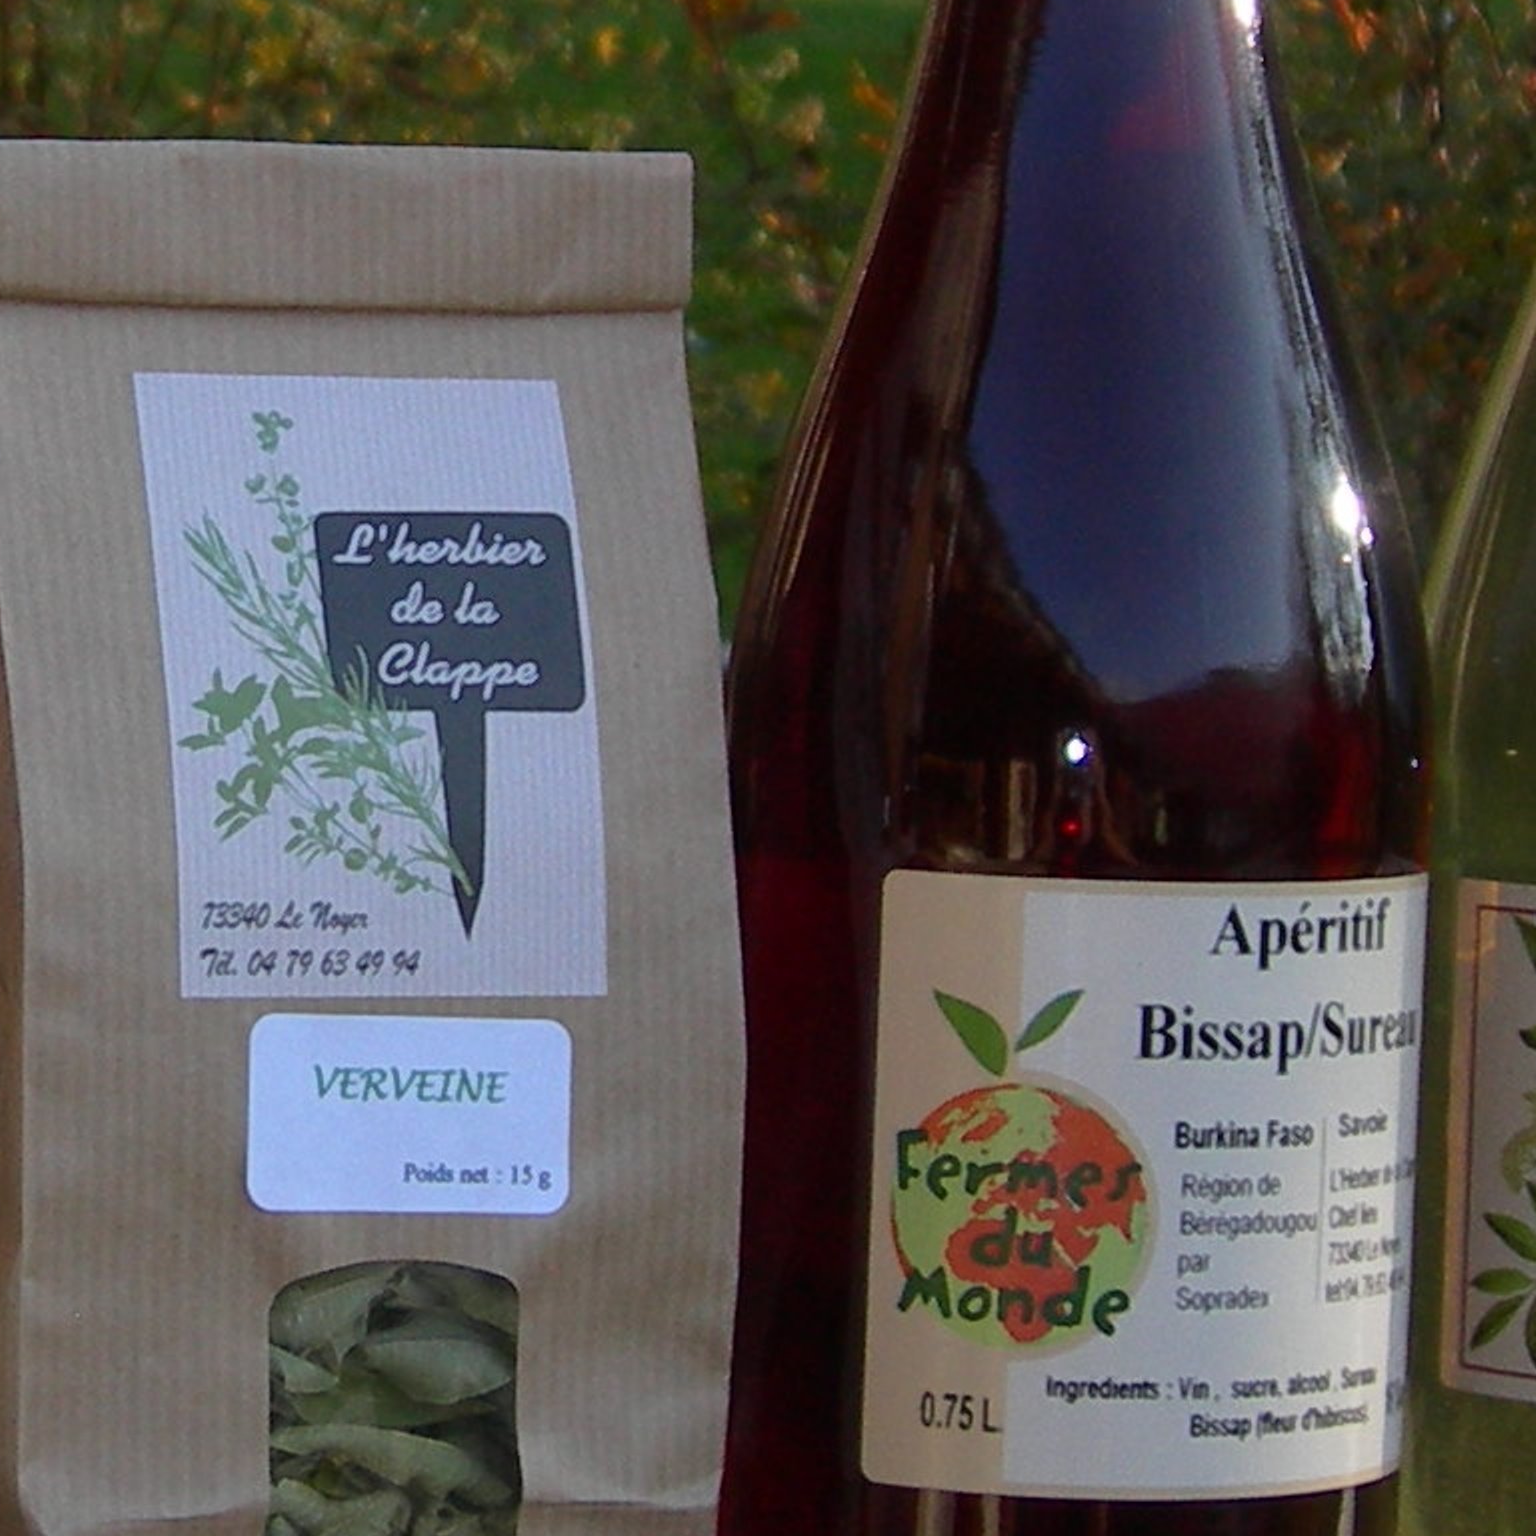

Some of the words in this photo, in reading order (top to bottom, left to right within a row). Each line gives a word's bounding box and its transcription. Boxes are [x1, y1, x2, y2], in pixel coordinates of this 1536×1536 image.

[334, 522, 546, 566] L'herbier
[391, 583, 444, 625] de
[454, 582, 500, 626] la
[378, 643, 538, 701] Clappe
[202, 902, 268, 930] 73340
[275, 902, 305, 930] Le
[309, 902, 368, 938] Noyer
[1210, 898, 1391, 970] Apéritif
[247, 951, 277, 977] 04
[285, 951, 313, 977] 79
[321, 951, 348, 977] 63
[356, 951, 386, 977] 49
[393, 951, 419, 977] 94
[314, 1064, 510, 1105] VERVEINE
[1175, 1121, 1260, 1149] Burkina
[1267, 1120, 1314, 1147] Faso
[404, 1163, 454, 1184] Poids
[459, 1165, 489, 1185] net
[510, 1164, 533, 1186] 15
[538, 1170, 552, 1191] g
[897, 1128, 1143, 1205] Fermes
[1181, 1174, 1253, 1203] Région
[1258, 1174, 1281, 1197] de
[970, 1207, 1054, 1268] du
[1177, 1254, 1211, 1279] par
[897, 1266, 1130, 1339] Monde
[920, 1392, 973, 1431] 0.75
[1189, 1414, 1252, 1440] Bissap
